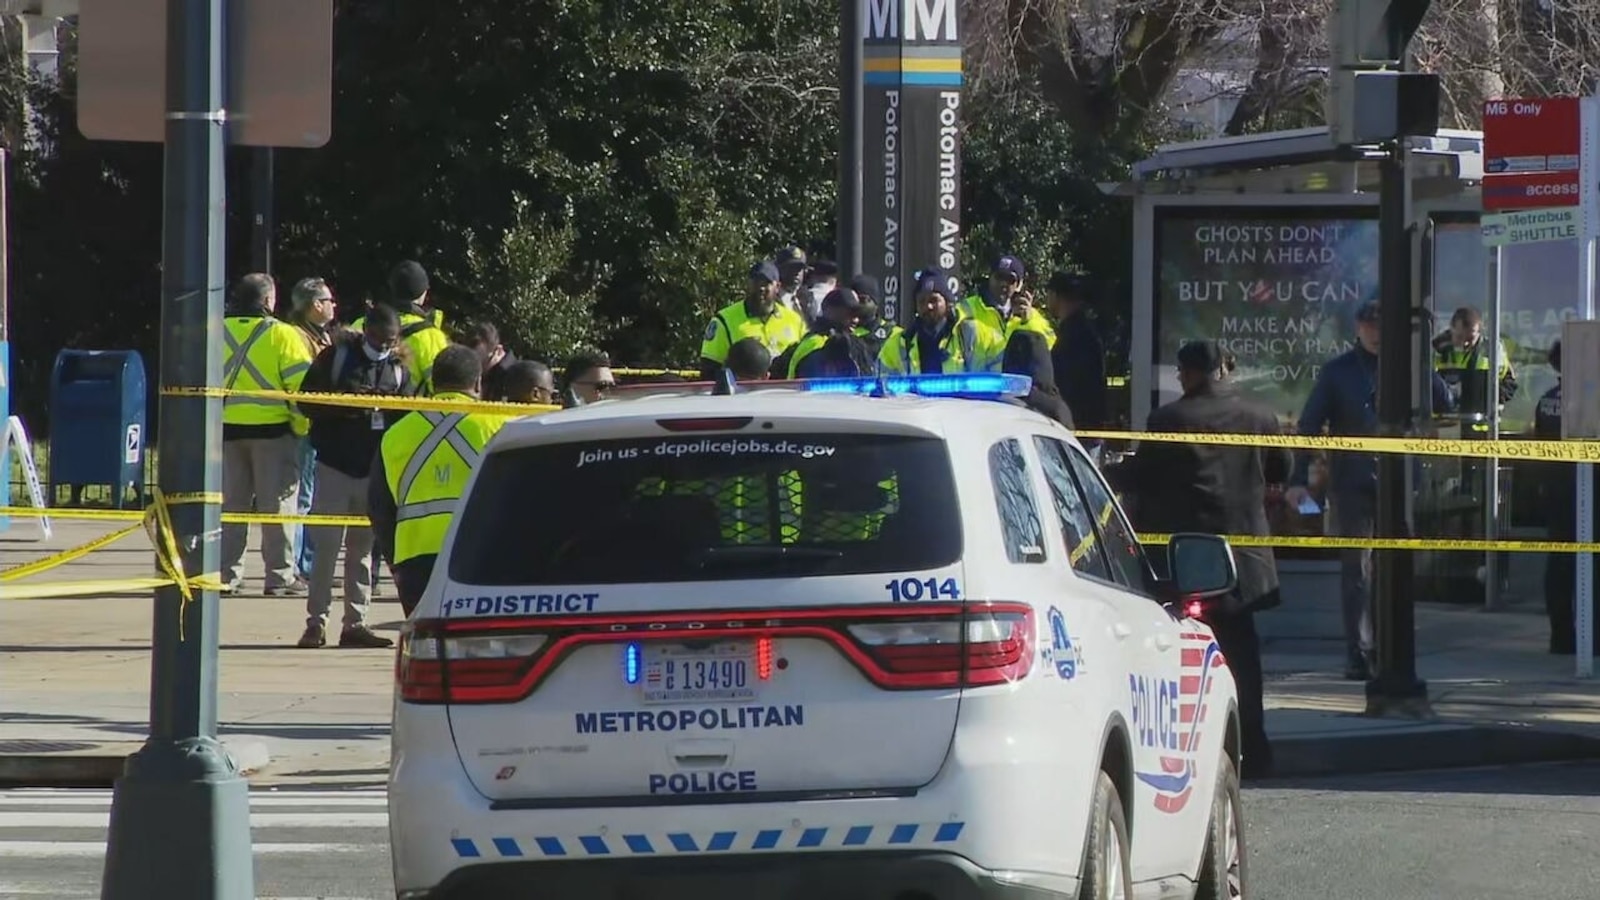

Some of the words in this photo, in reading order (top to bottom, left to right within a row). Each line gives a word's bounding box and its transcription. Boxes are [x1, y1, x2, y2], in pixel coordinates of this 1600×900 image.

[904, 0, 957, 40] M
[1486, 103, 1508, 115] M6
[1514, 102, 1542, 117] Only
[885, 90, 898, 208] Potomac
[940, 91, 959, 209] Potomac
[1526, 184, 1578, 196] access
[1507, 211, 1572, 225] Metrobus
[885, 218, 898, 267] Ave
[940, 218, 959, 268] Ave
[1195, 226, 1273, 242] GHOSTS
[1280, 225, 1342, 242] DON'T
[1510, 225, 1575, 241] SHUTTLE
[1204, 248, 1256, 264] PLAN
[1263, 248, 1335, 263] AHEAD
[885, 276, 898, 321] Sta
[1179, 281, 1228, 301] BUT
[1302, 281, 1360, 300] CAN
[1222, 317, 1277, 333] MAKE
[1284, 317, 1315, 332] AN
[1179, 338, 1299, 354] ERGENCY
[577, 449, 613, 468] Join
[618, 446, 638, 459] us
[654, 440, 836, 459] dcpolicejobs.dc.gov
[1404, 442, 1463, 454] CROSS
[1467, 444, 1502, 456] NOT
[1507, 445, 1531, 457] DO
[1537, 447, 1574, 459] LINE
[885, 578, 960, 602] 1014
[475, 593, 599, 615] DISTRICT
[682, 660, 746, 690] 13490
[575, 705, 804, 733] METROPOLITAN
[1129, 673, 1178, 750] POLICE
[649, 770, 757, 793] POLICE
